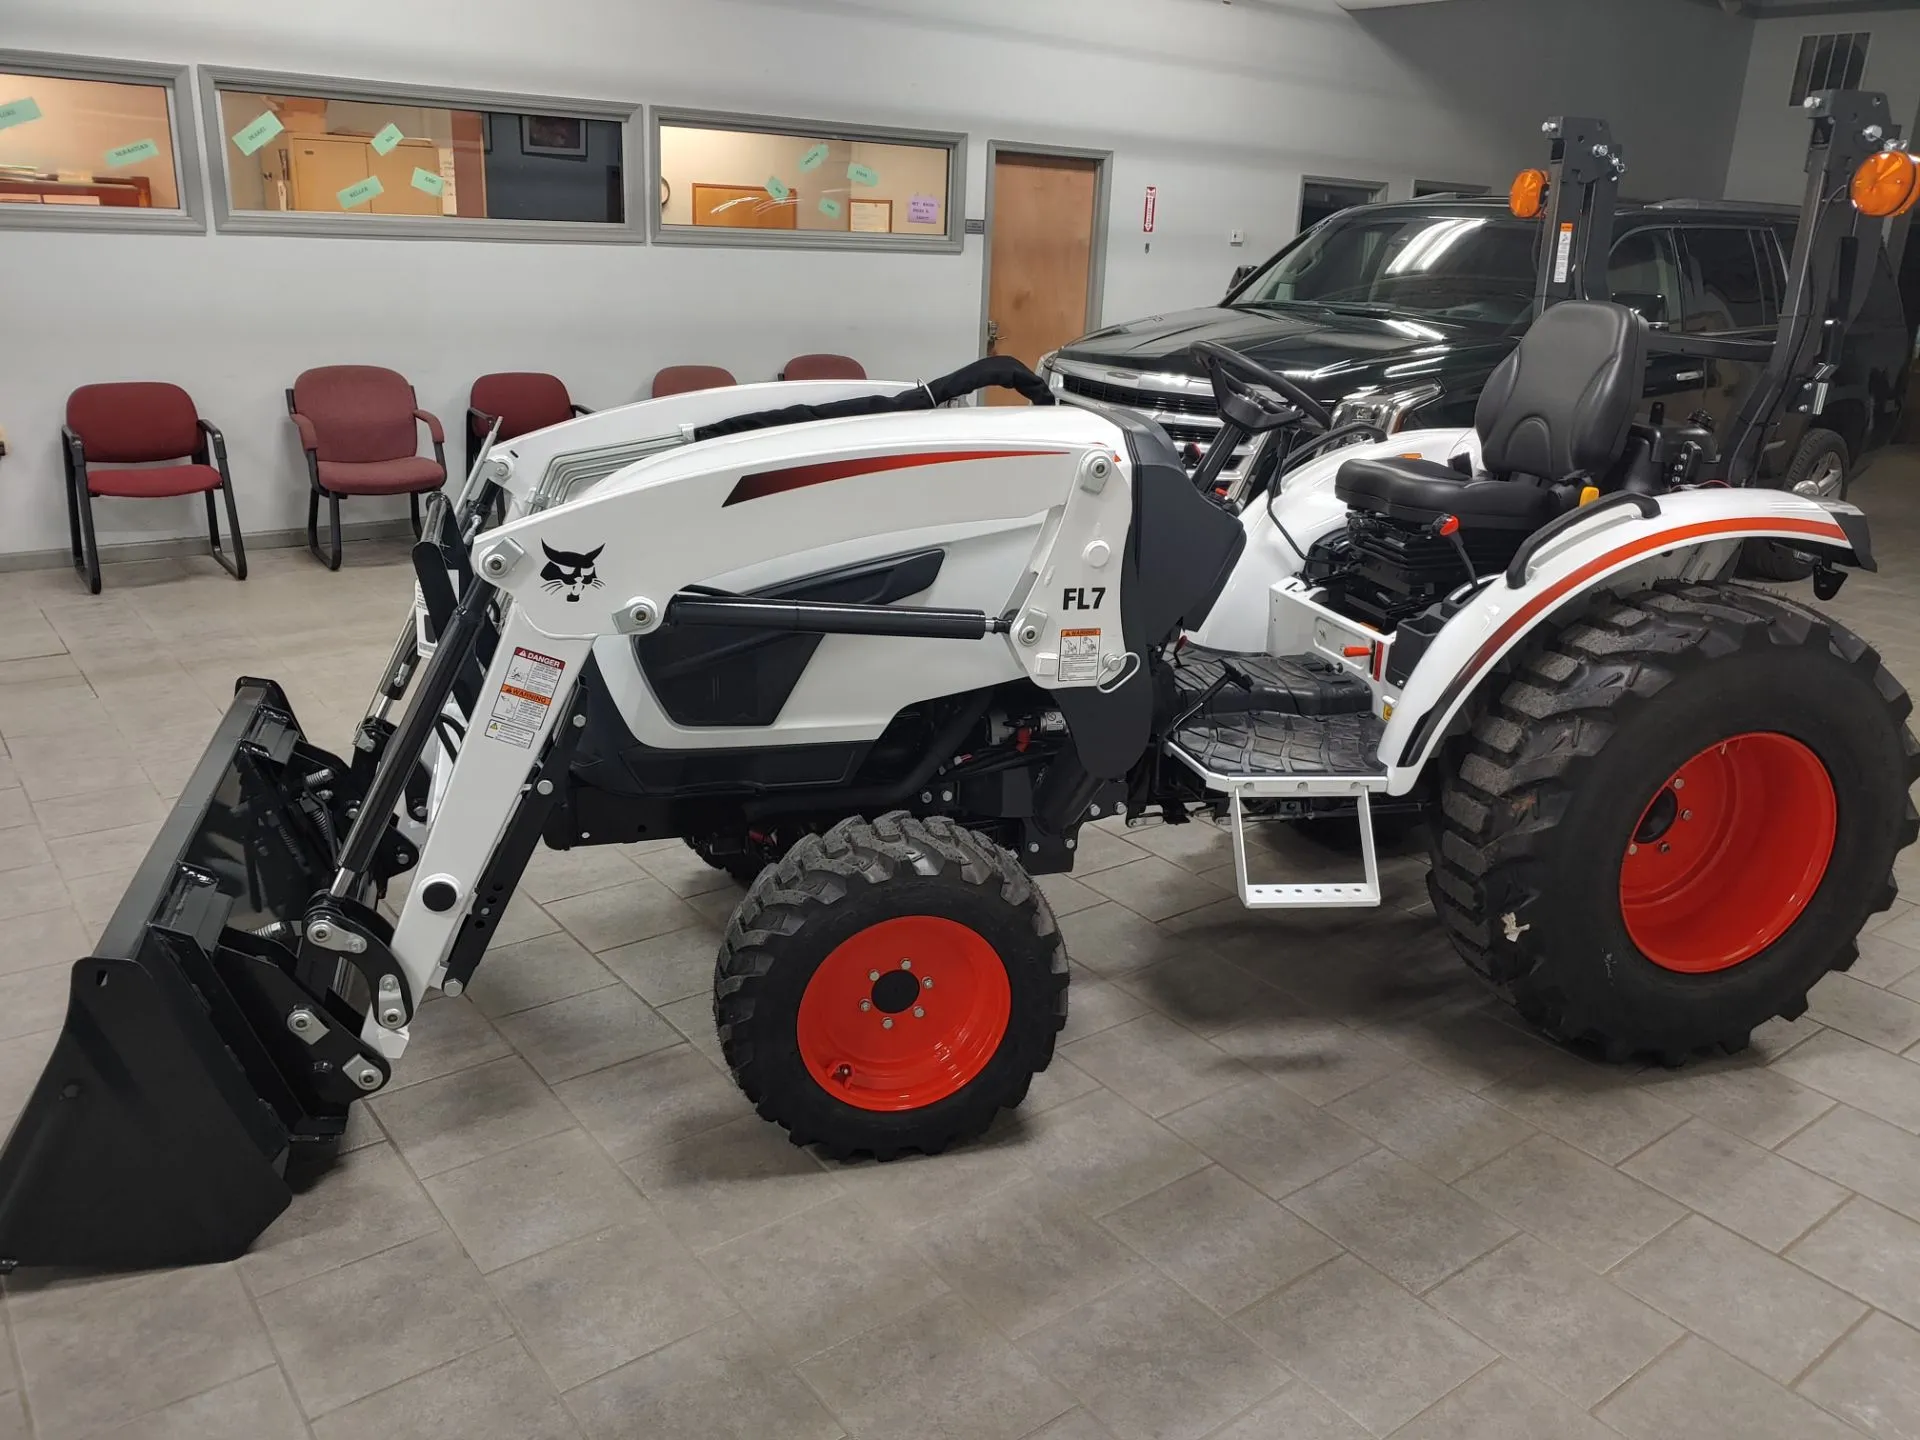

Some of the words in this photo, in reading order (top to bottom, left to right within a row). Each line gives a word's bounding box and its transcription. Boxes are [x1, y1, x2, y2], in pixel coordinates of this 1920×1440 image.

[1063, 587, 1106, 610] FL7
[527, 652, 561, 668] DANGER
[511, 687, 547, 704] WARNING
